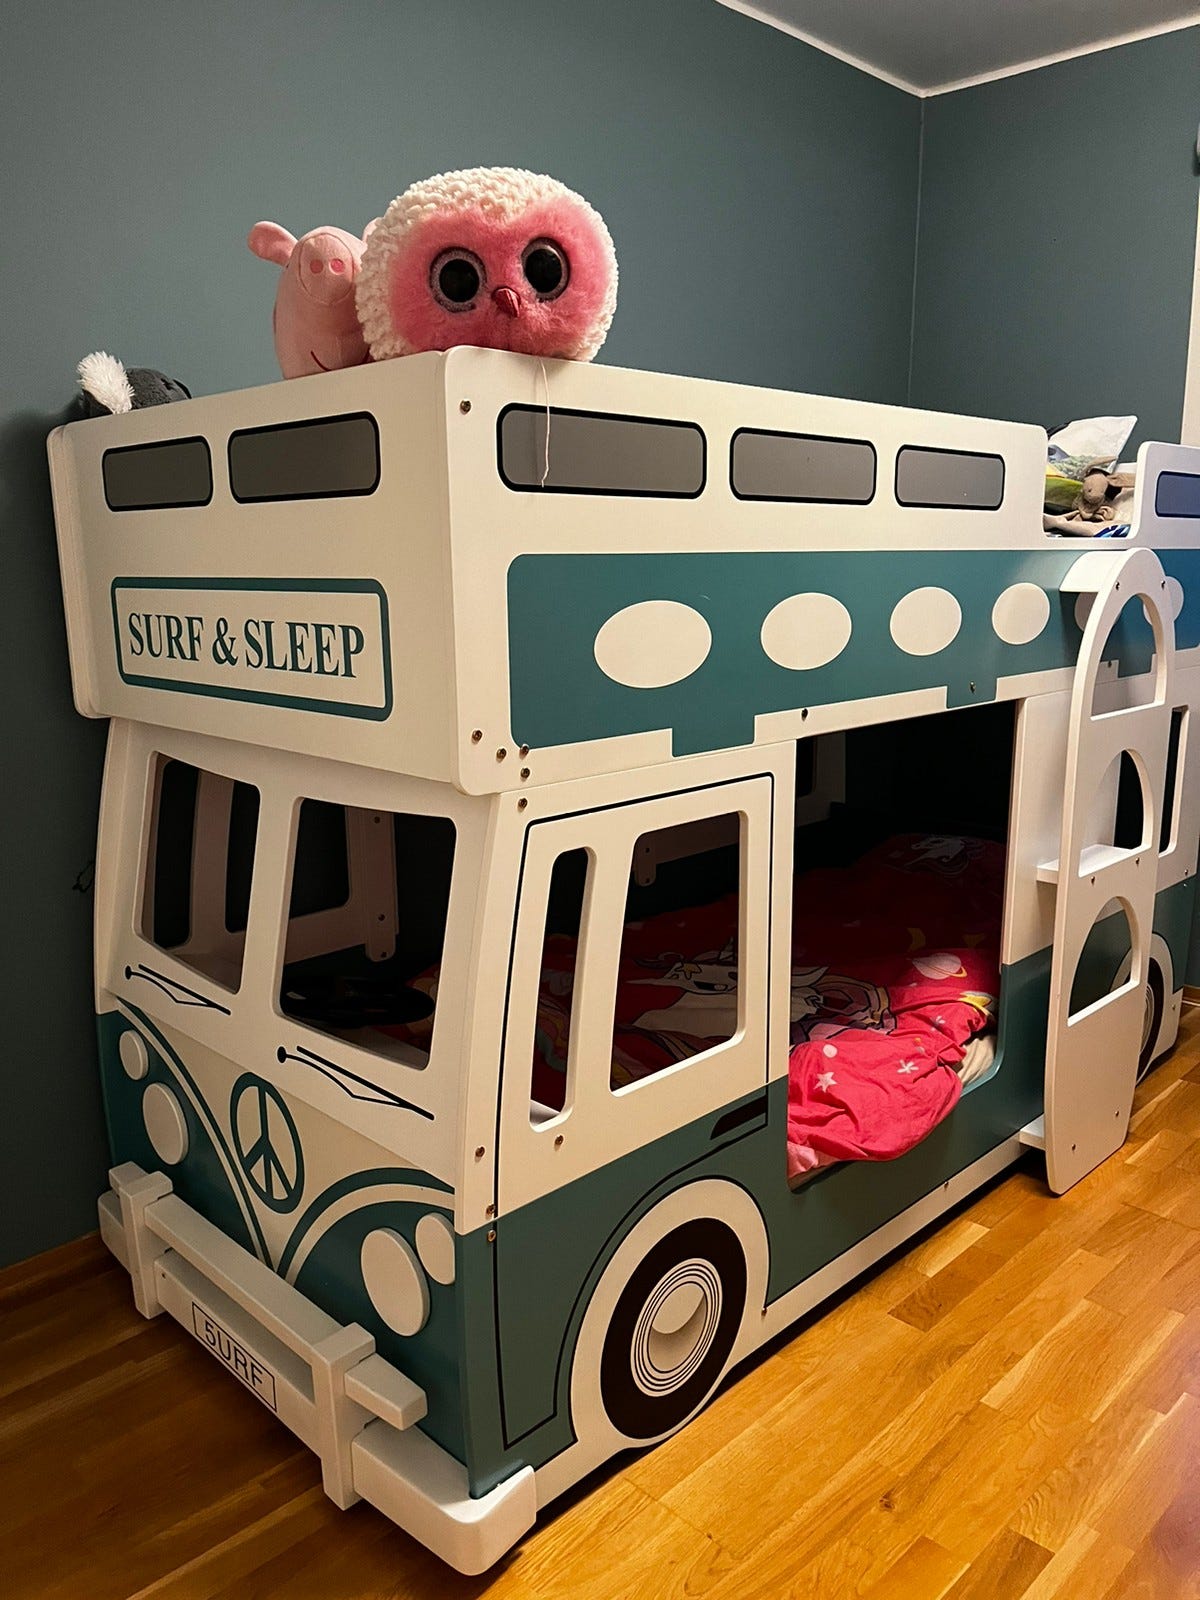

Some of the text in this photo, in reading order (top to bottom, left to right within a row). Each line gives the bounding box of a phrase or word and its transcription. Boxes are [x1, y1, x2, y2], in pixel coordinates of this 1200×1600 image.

[128, 612, 365, 678] SURF & SLEEP
